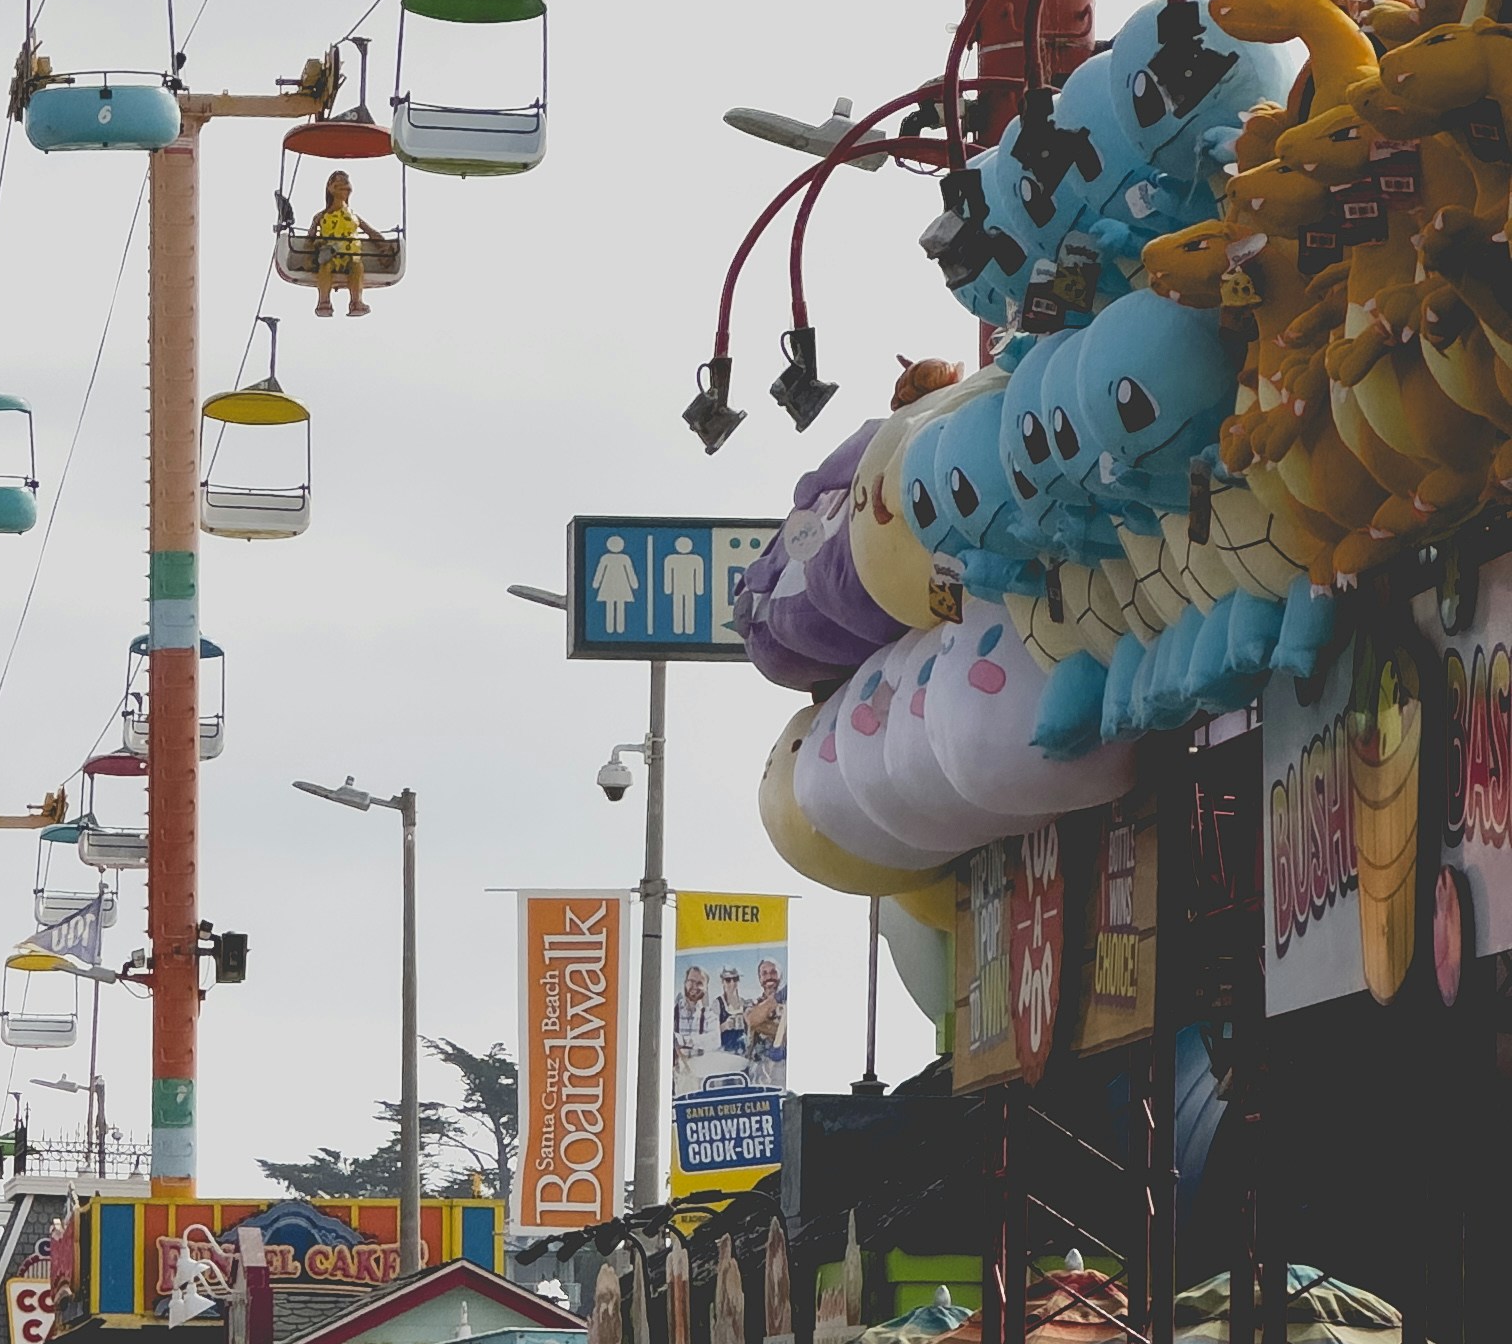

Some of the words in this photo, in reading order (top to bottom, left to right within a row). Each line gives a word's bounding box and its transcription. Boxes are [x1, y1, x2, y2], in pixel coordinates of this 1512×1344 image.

[98, 105, 112, 124] 6
[1443, 644, 1512, 844] BAS
[704, 903, 760, 923] WINTER
[1108, 875, 1134, 927] WINS
[1095, 930, 1139, 998] CHOICE!
[539, 969, 560, 1032] Beach
[1018, 941, 1053, 1053] POP
[536, 901, 607, 1225] Boardwalk
[541, 1057, 560, 1111] Cruz
[686, 1106, 715, 1119] SANTA
[717, 1103, 742, 1116] CRUZ
[744, 1100, 771, 1113] CLAM
[686, 1115, 775, 1143] CHOWDER
[536, 1113, 555, 1171] Santa
[688, 1137, 775, 1165] COOK-OFF
[305, 1240, 428, 1285] CAKE
